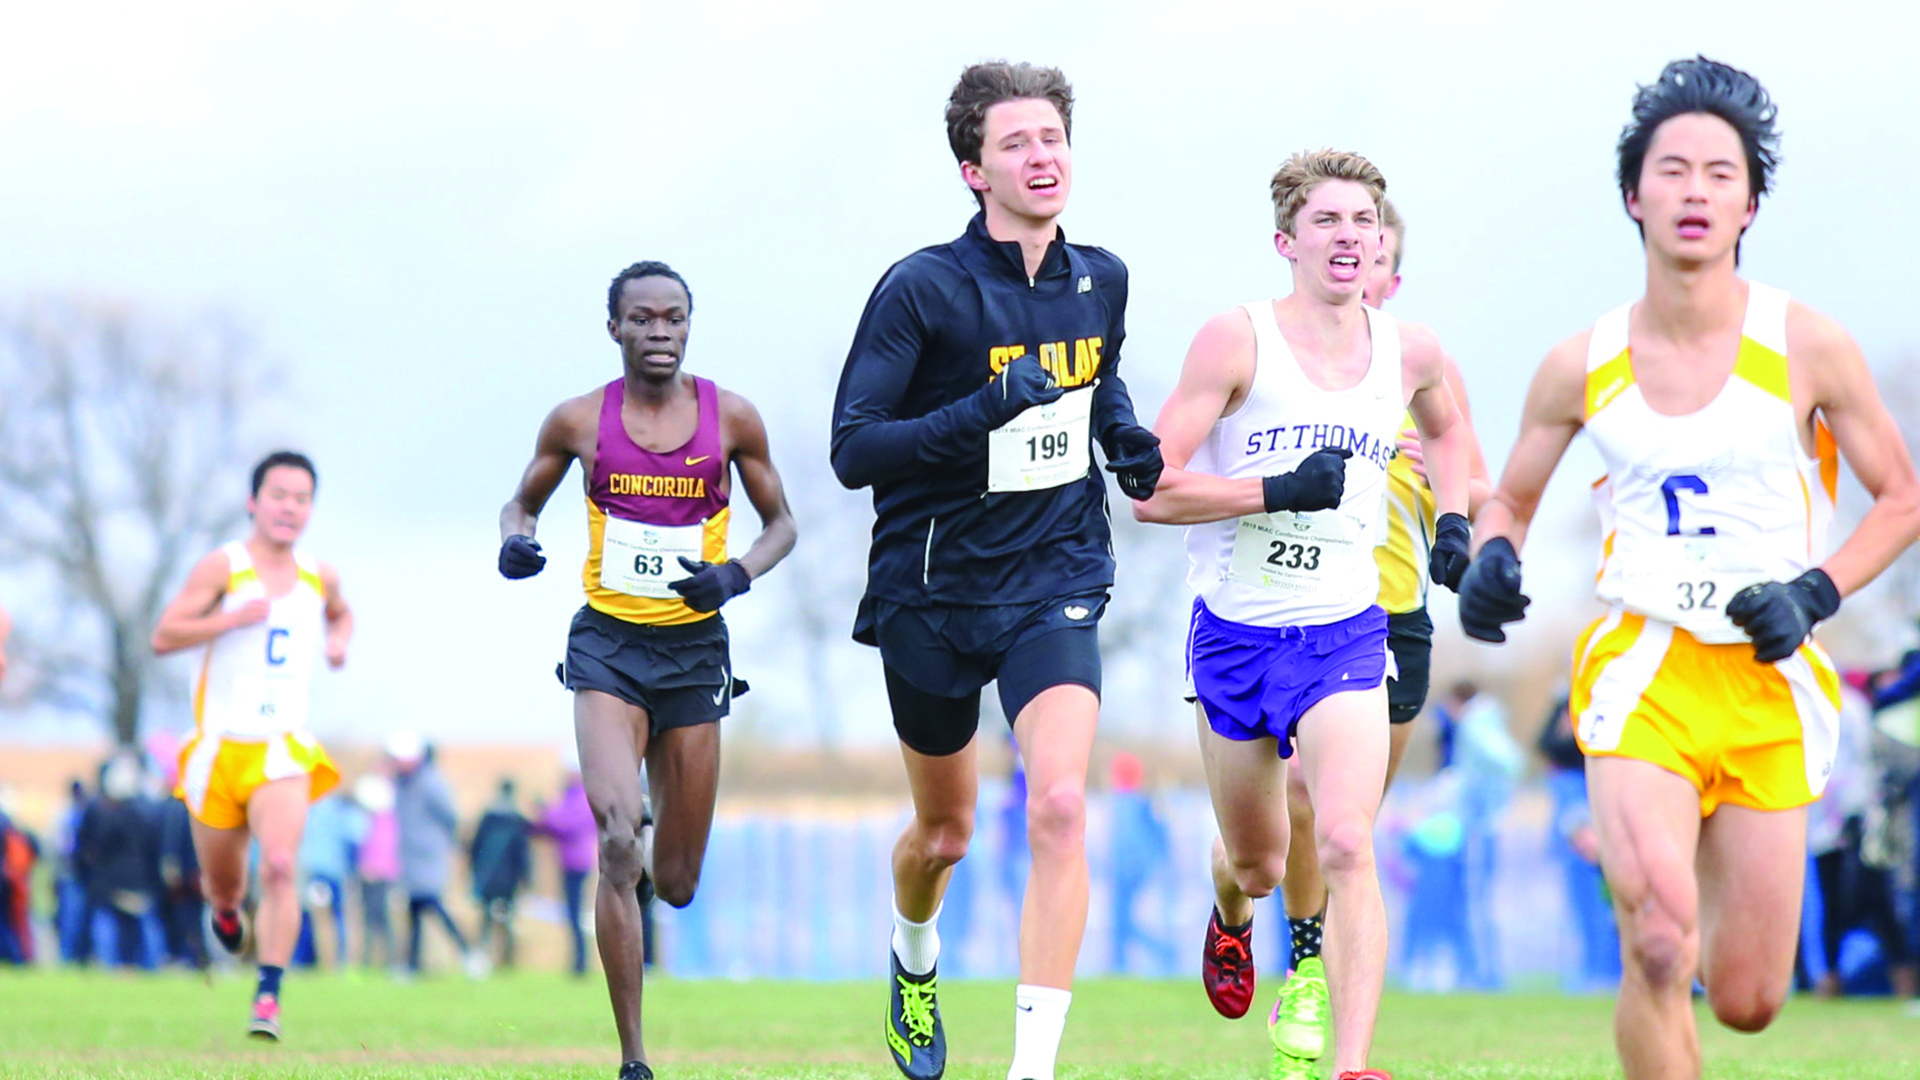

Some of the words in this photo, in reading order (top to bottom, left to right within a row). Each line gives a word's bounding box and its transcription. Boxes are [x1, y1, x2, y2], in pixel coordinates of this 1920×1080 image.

[1026, 431, 1068, 462] 199
[609, 473, 705, 498] CONCORDIA
[1274, 530, 1309, 541] Conference
[634, 554, 663, 576] 63
[1266, 540, 1321, 571] 233
[1676, 580, 1717, 610] 32
[266, 628, 290, 666] C
